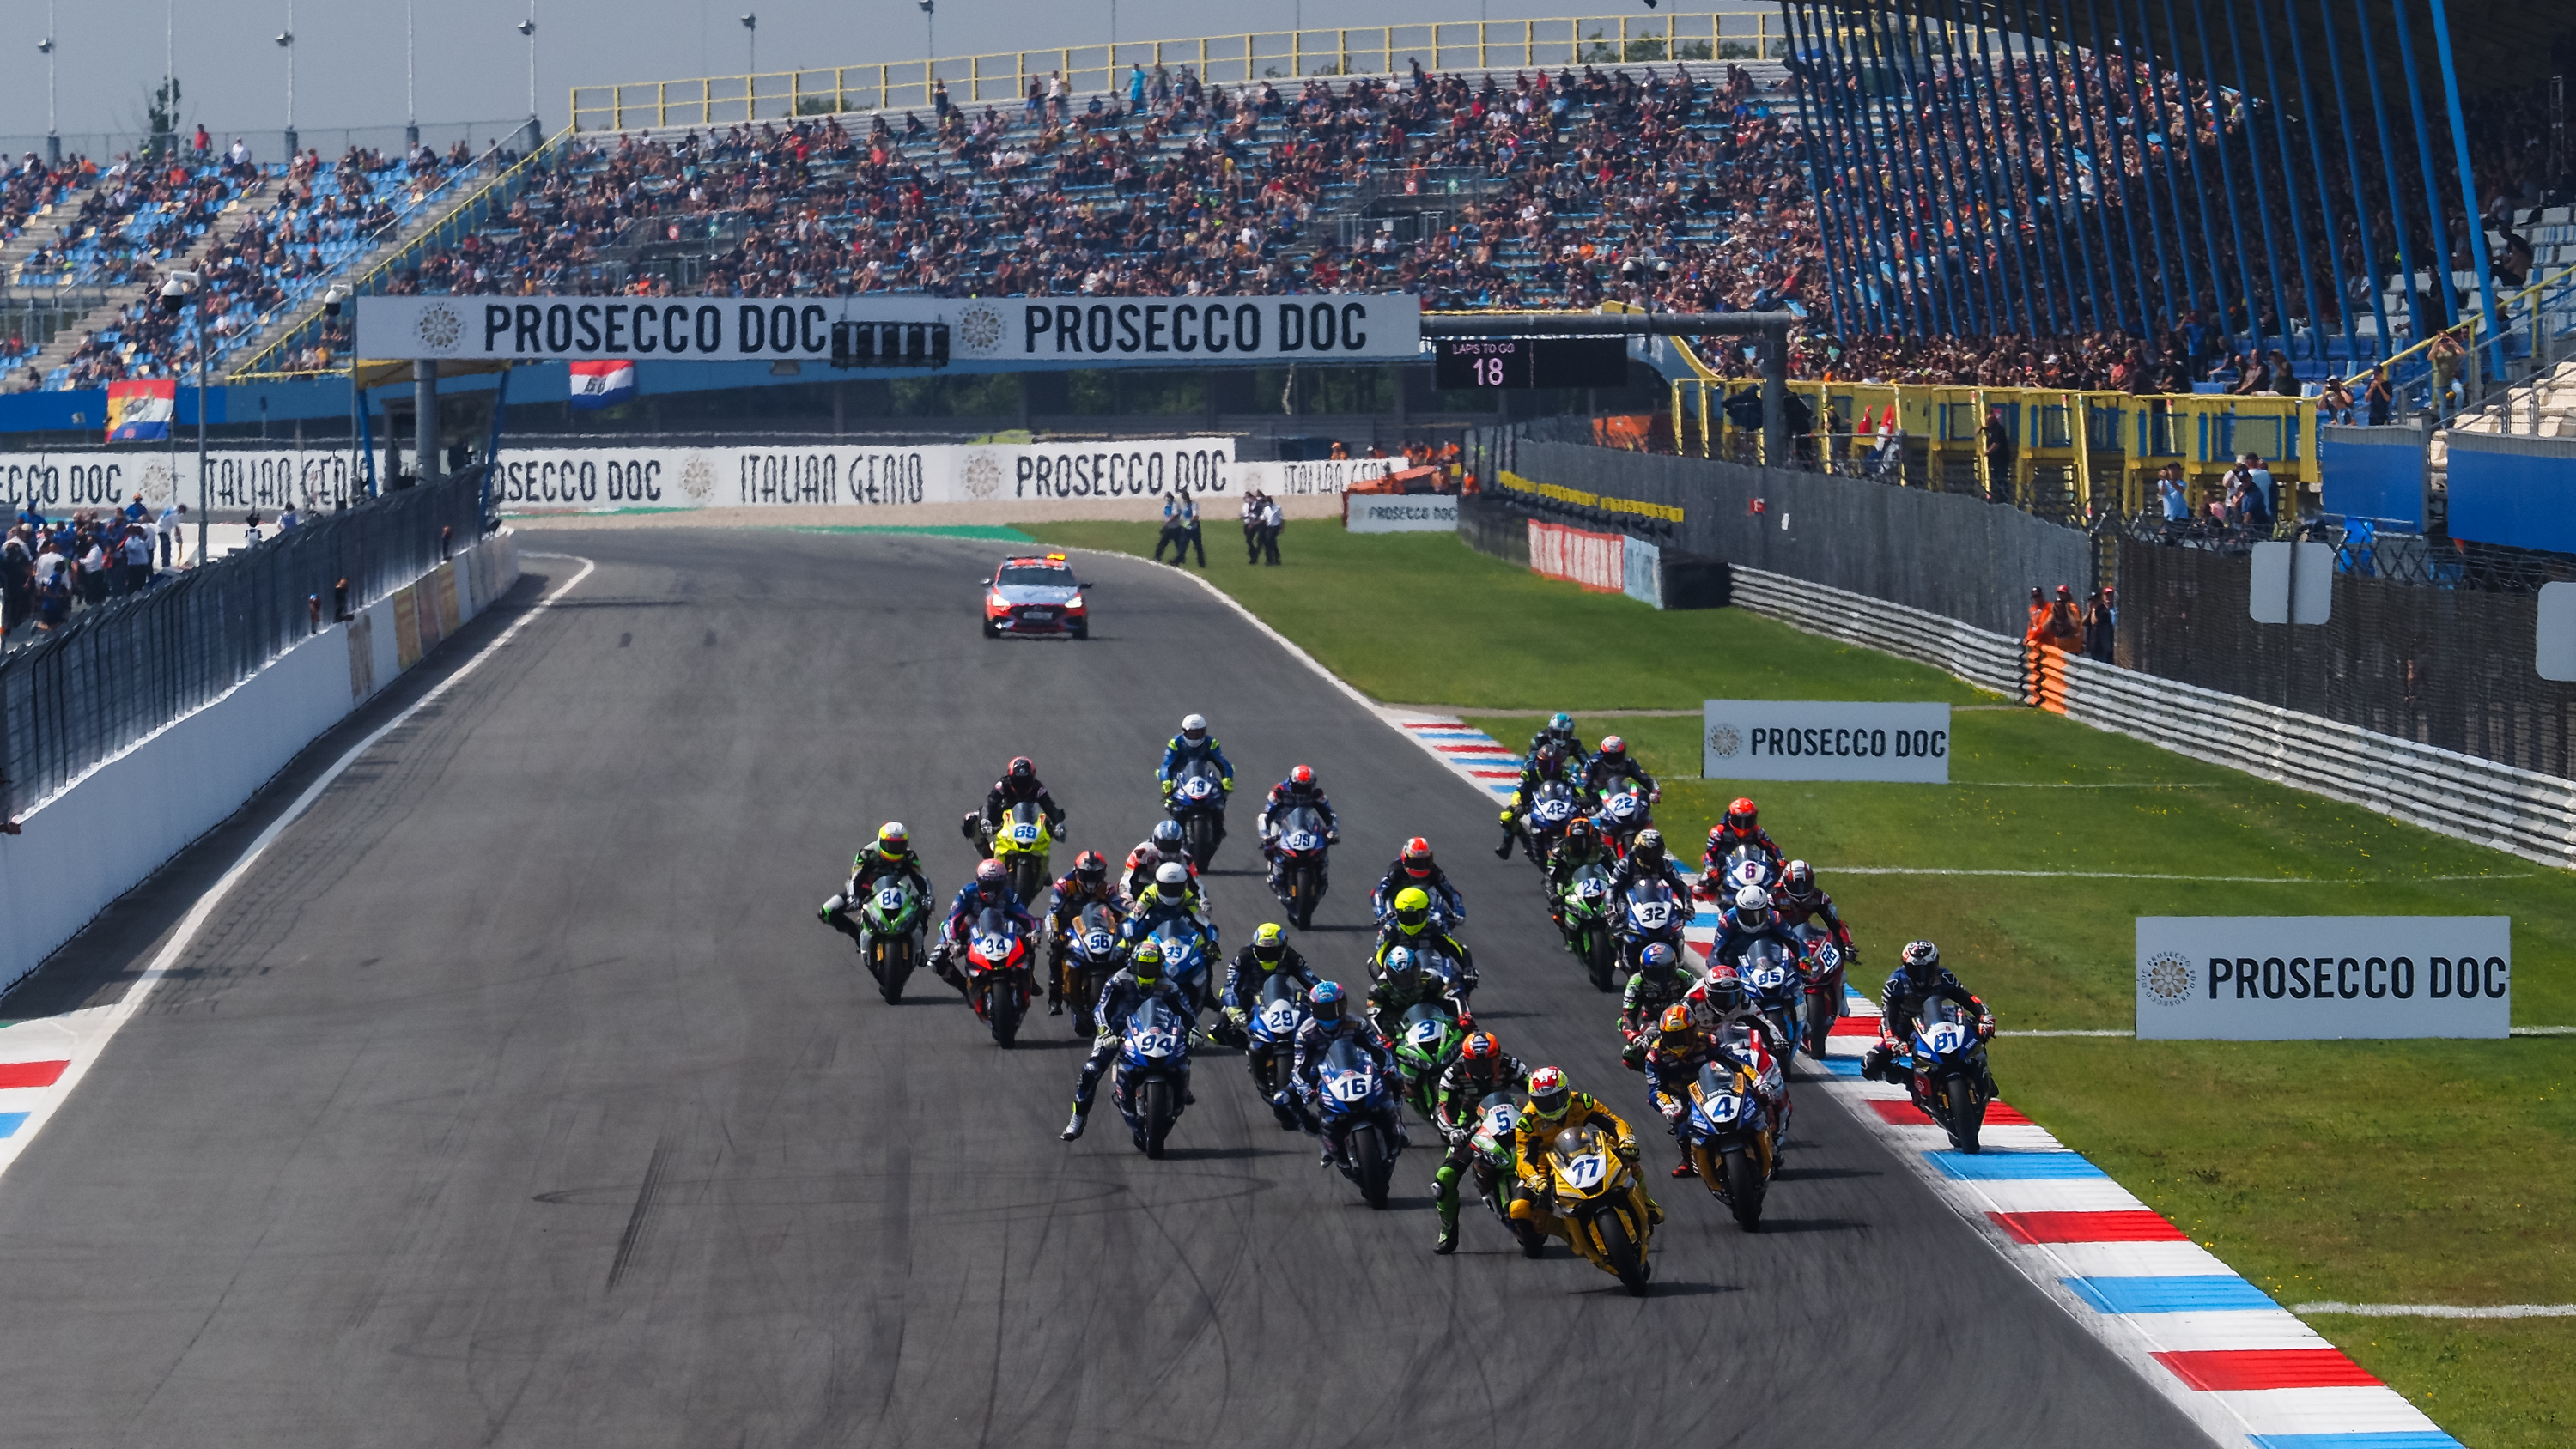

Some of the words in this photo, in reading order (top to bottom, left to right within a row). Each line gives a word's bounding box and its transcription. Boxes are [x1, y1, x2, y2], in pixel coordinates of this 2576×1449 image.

[485, 304, 721, 354] PROSECCO
[739, 305, 826, 353] DOC
[1025, 304, 1261, 353] PROSECCO
[1279, 302, 1366, 352] DOC
[1453, 344, 1480, 355] LAPS
[1482, 343, 1497, 354] TO
[1498, 343, 1515, 354] GO
[1473, 357, 1503, 385] 18
[608, 460, 662, 501] DOC
[741, 453, 835, 505] ITALIAN
[849, 453, 923, 504] GENIO
[1017, 452, 1163, 496] PROSECCO
[1176, 450, 1226, 493] DOC
[70, 464, 121, 504] DOC
[1752, 728, 1886, 756] PROSECCO
[1896, 730, 1946, 757] DOC
[1546, 803, 1564, 815] 42
[1614, 797, 1635, 811] 22
[1014, 825, 1037, 840] 69
[1293, 833, 1310, 846] 99
[1745, 862, 1757, 880] 6
[1583, 880, 1601, 894] 24
[882, 888, 902, 906] 84
[1642, 907, 1666, 923] 32
[986, 938, 1006, 955] 34
[1091, 934, 1110, 949] 56
[1167, 946, 1183, 959] 33
[1758, 972, 1781, 986] 95
[2209, 957, 2414, 999] PROSECCO
[2430, 957, 2506, 998] DOC
[1270, 1009, 1293, 1028] 29
[1418, 1020, 1436, 1039] 3
[1140, 1034, 1174, 1052] 94
[1934, 1032, 1958, 1052] 81
[1340, 1077, 1367, 1100] 16
[1713, 1096, 1735, 1118] 4
[1495, 1111, 1511, 1131] 5
[1571, 1158, 1600, 1186] 77
